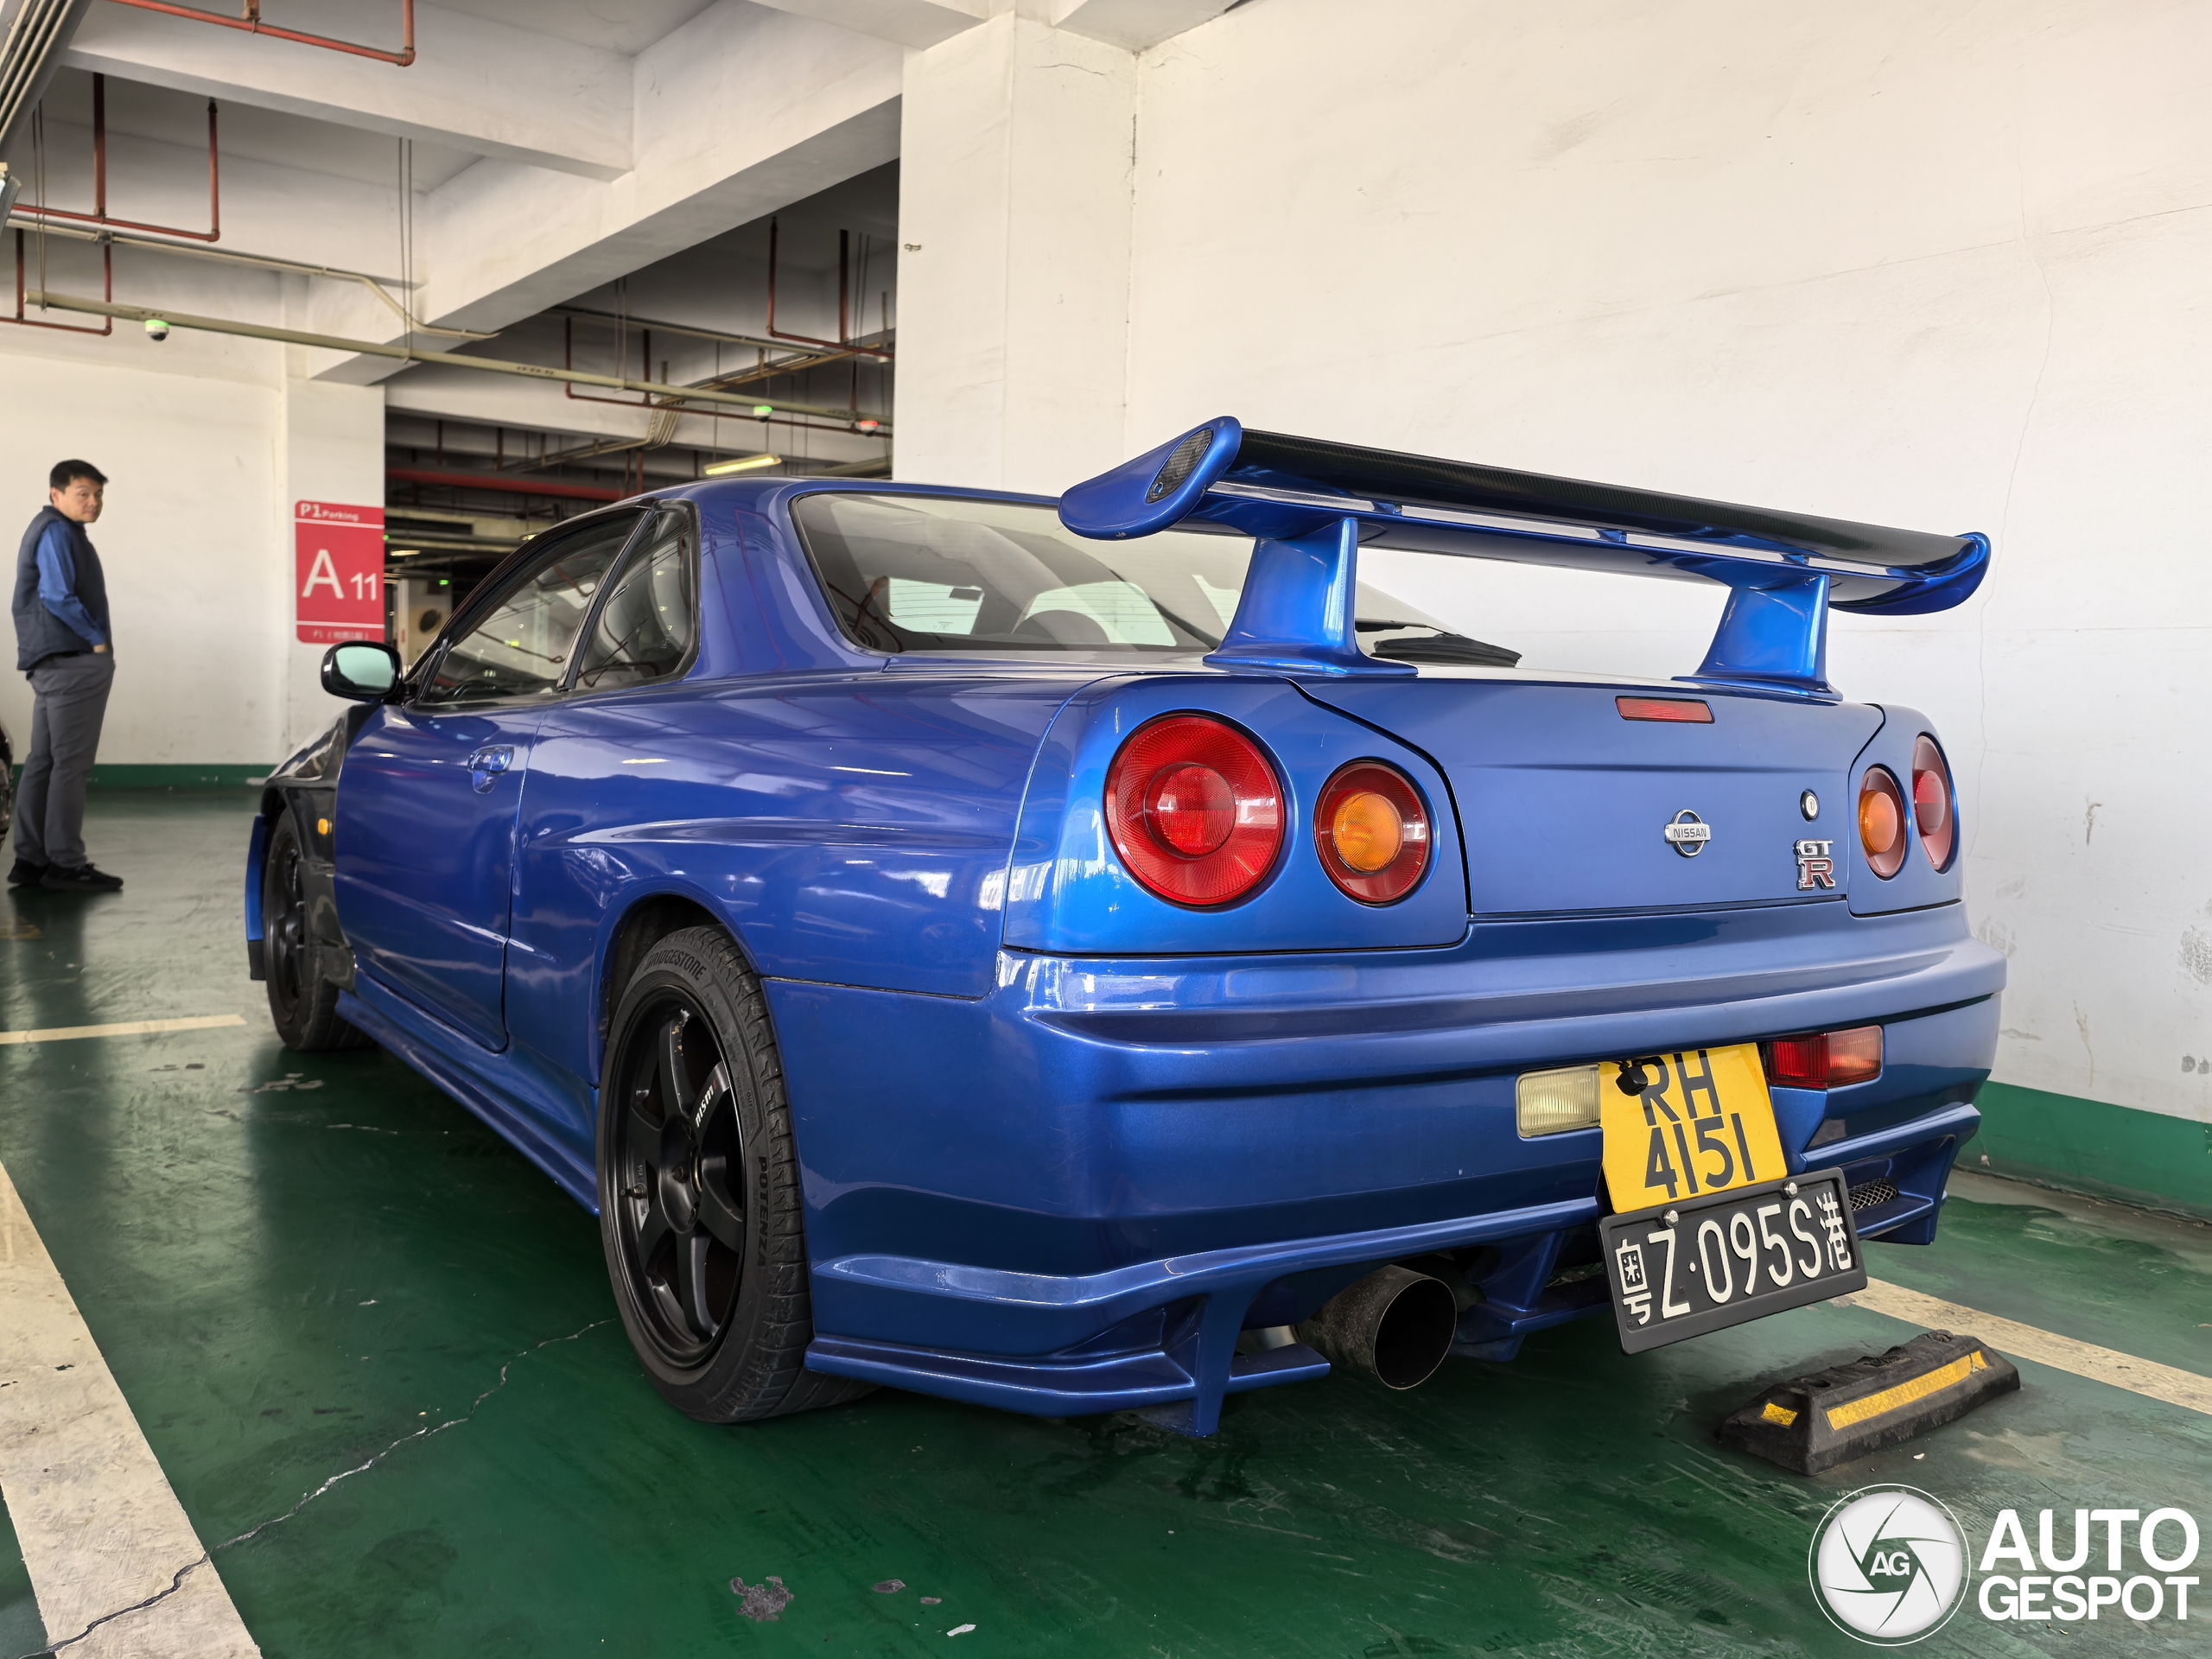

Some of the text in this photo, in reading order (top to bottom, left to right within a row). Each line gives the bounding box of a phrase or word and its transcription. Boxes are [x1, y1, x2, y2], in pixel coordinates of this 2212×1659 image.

[300, 502, 322, 518] P1
[302, 548, 378, 601] A 11
[1673, 827, 1707, 838] NISSAN
[1796, 839, 1834, 856] GT
[1800, 857, 1835, 889] R
[1637, 1049, 1722, 1127] RH
[1644, 1112, 1756, 1199] 4151
[757, 1155, 769, 1267] POTENZA
